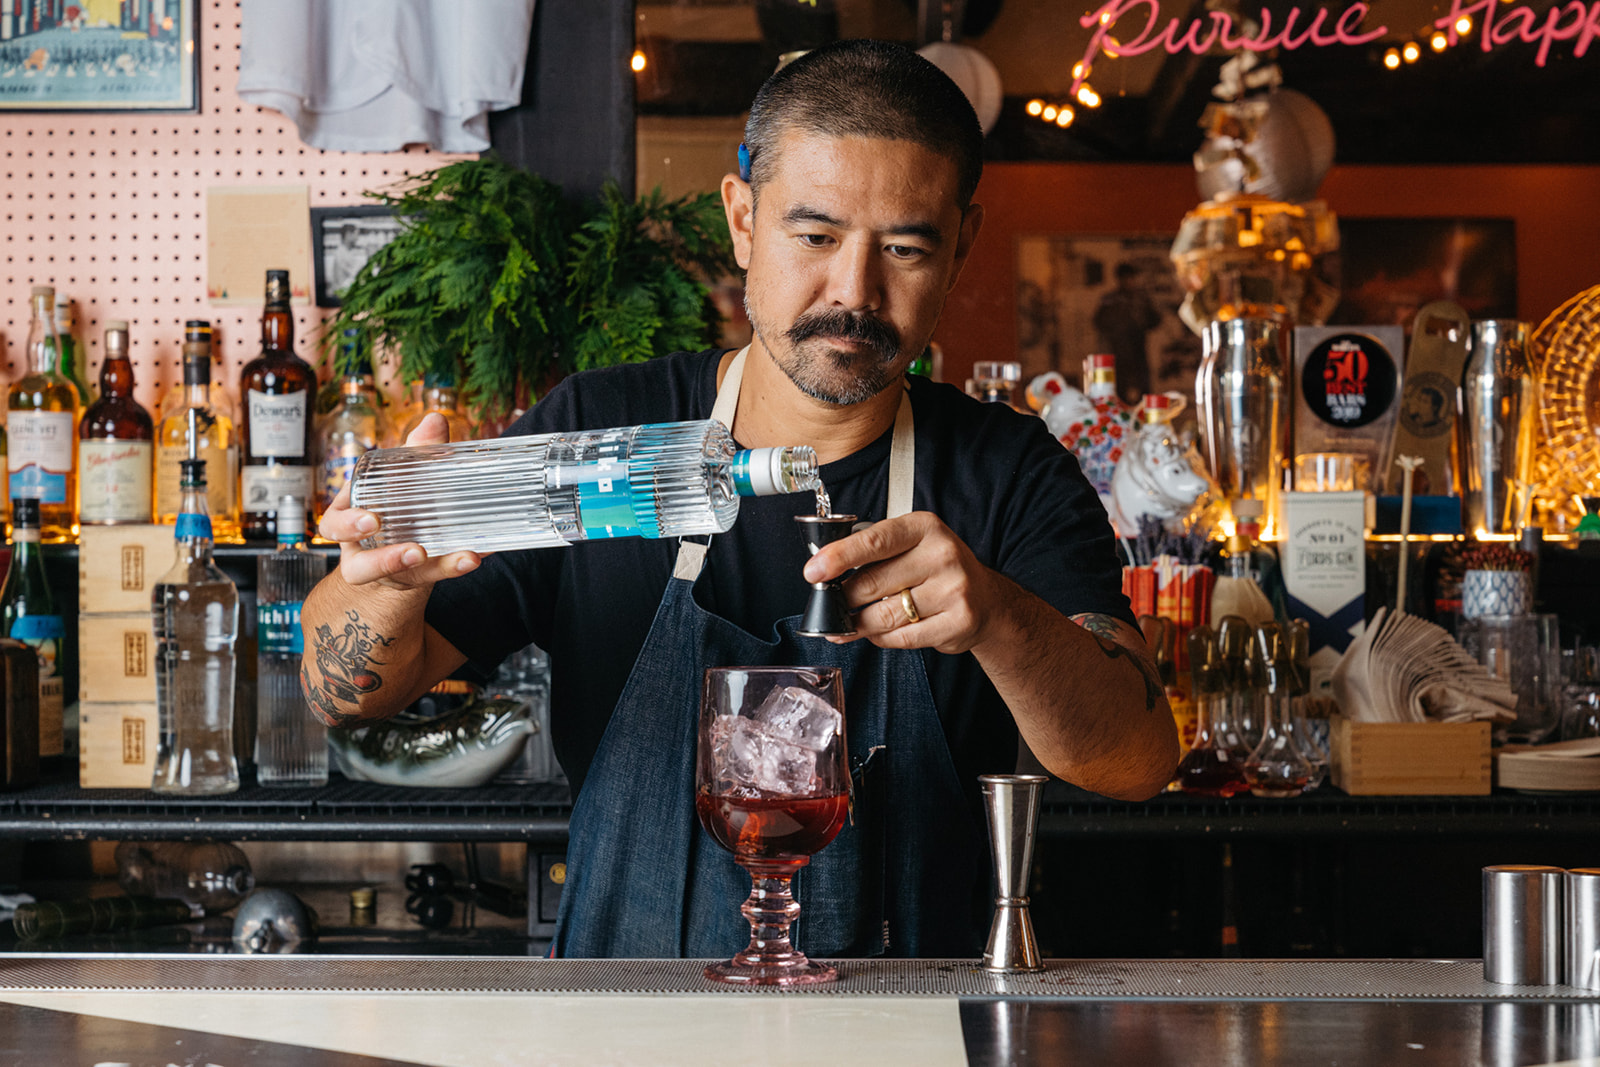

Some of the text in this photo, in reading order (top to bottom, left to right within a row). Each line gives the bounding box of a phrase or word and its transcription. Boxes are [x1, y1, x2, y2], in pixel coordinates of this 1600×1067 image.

[1070, 0, 1388, 95] Pursue
[1323, 350, 1369, 381] 50
[1325, 380, 1368, 395] BEST
